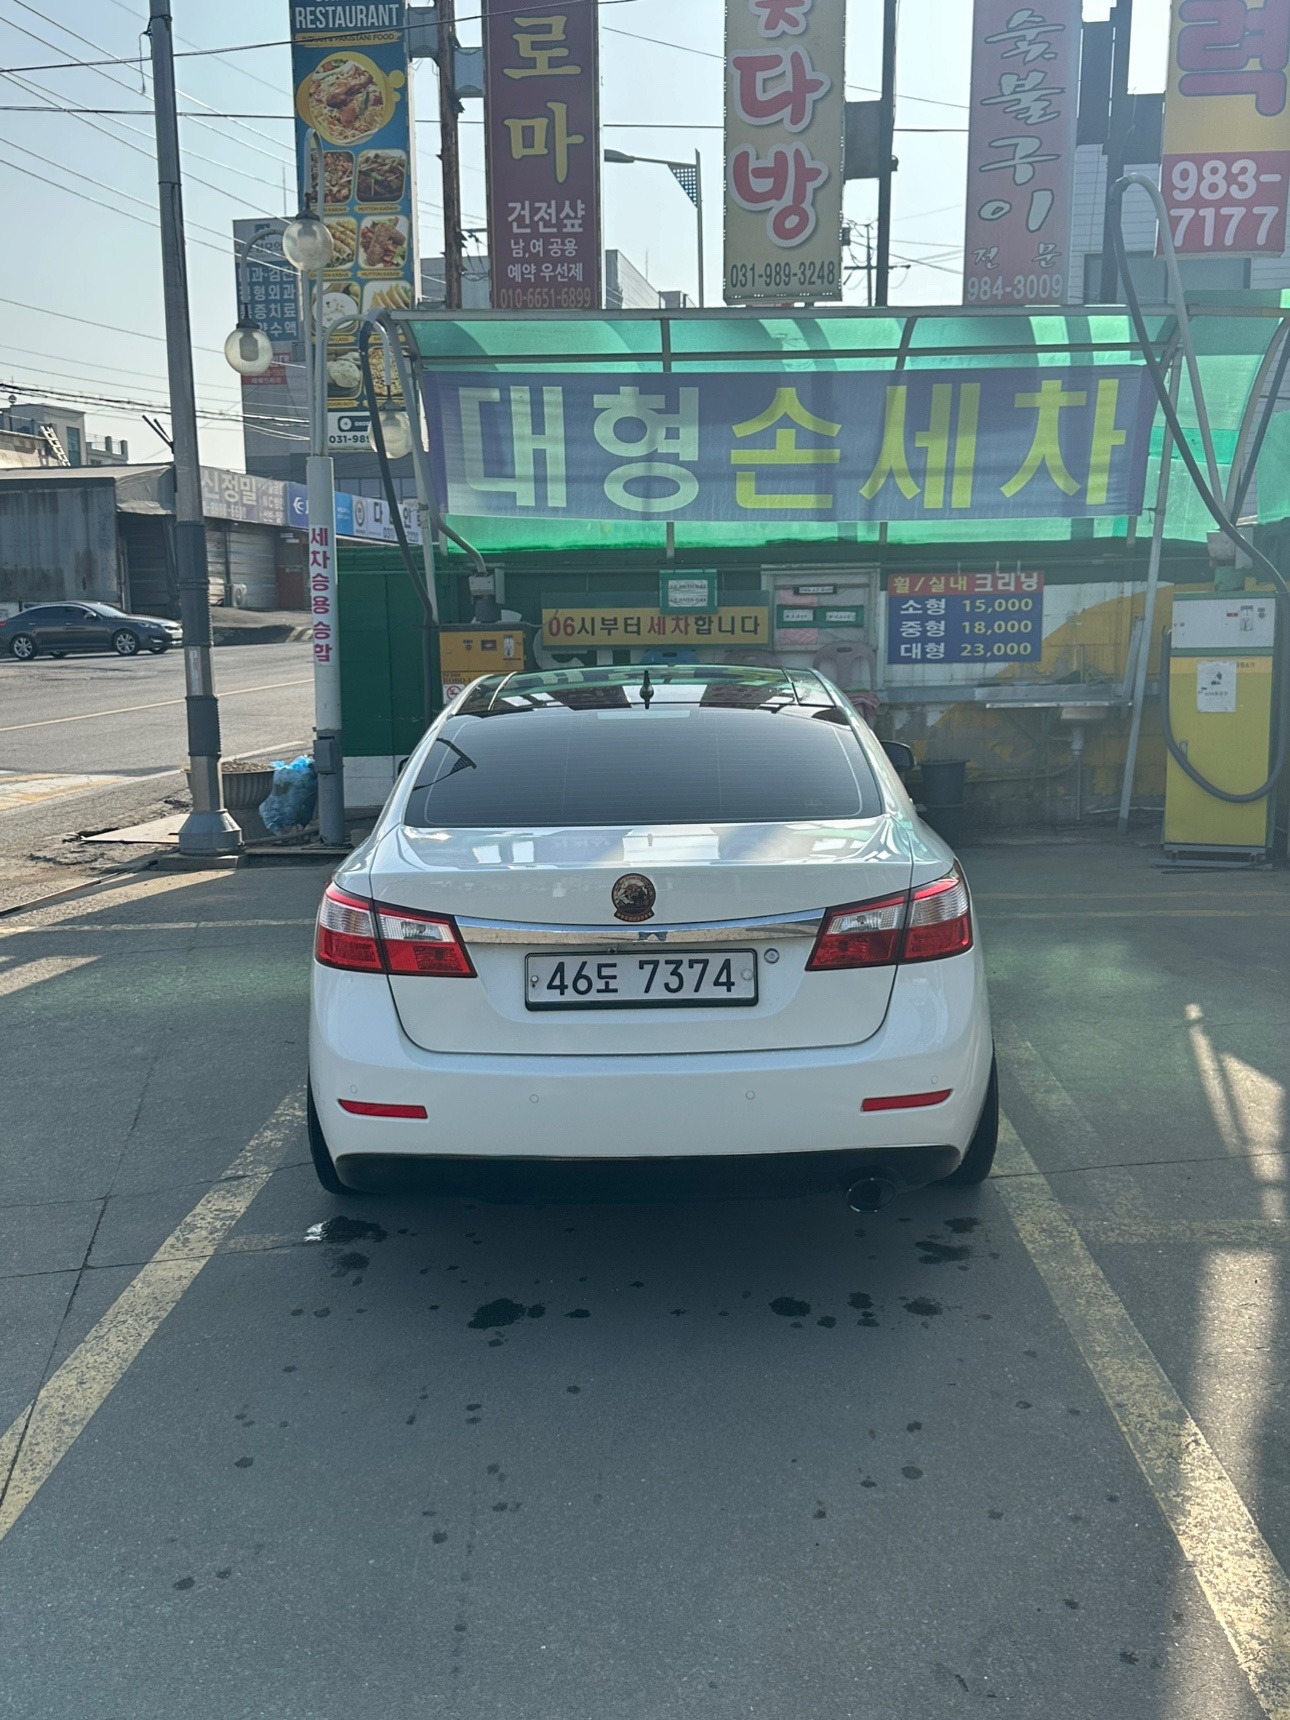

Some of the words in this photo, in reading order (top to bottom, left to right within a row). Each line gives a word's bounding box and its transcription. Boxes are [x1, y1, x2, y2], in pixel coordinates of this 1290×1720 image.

[294, 4, 399, 29] RESTAURANT
[502, 15, 585, 183] 로마
[1171, 158, 1282, 201] 983-
[507, 199, 586, 234] 건전샾
[1169, 205, 1279, 247] 7177
[510, 238, 543, 258] 남,여
[548, 238, 578, 257] 공용
[507, 263, 537, 282] 예약
[540, 262, 583, 282] 우선제
[730, 260, 835, 288] 031-989-3248
[501, 287, 591, 308] 010-6651-6899
[967, 273, 1063, 301] 984-3009
[974, 572, 1039, 592] 크리닝
[900, 598, 946, 616] 소형
[962, 598, 1033, 614] 15,000
[900, 620, 946, 638] 중형
[962, 620, 1033, 635] 18,000
[900, 642, 945, 660] 대형
[960, 642, 1032, 658] 23,000
[546, 960, 619, 996] 46도
[638, 958, 736, 994] 7374
